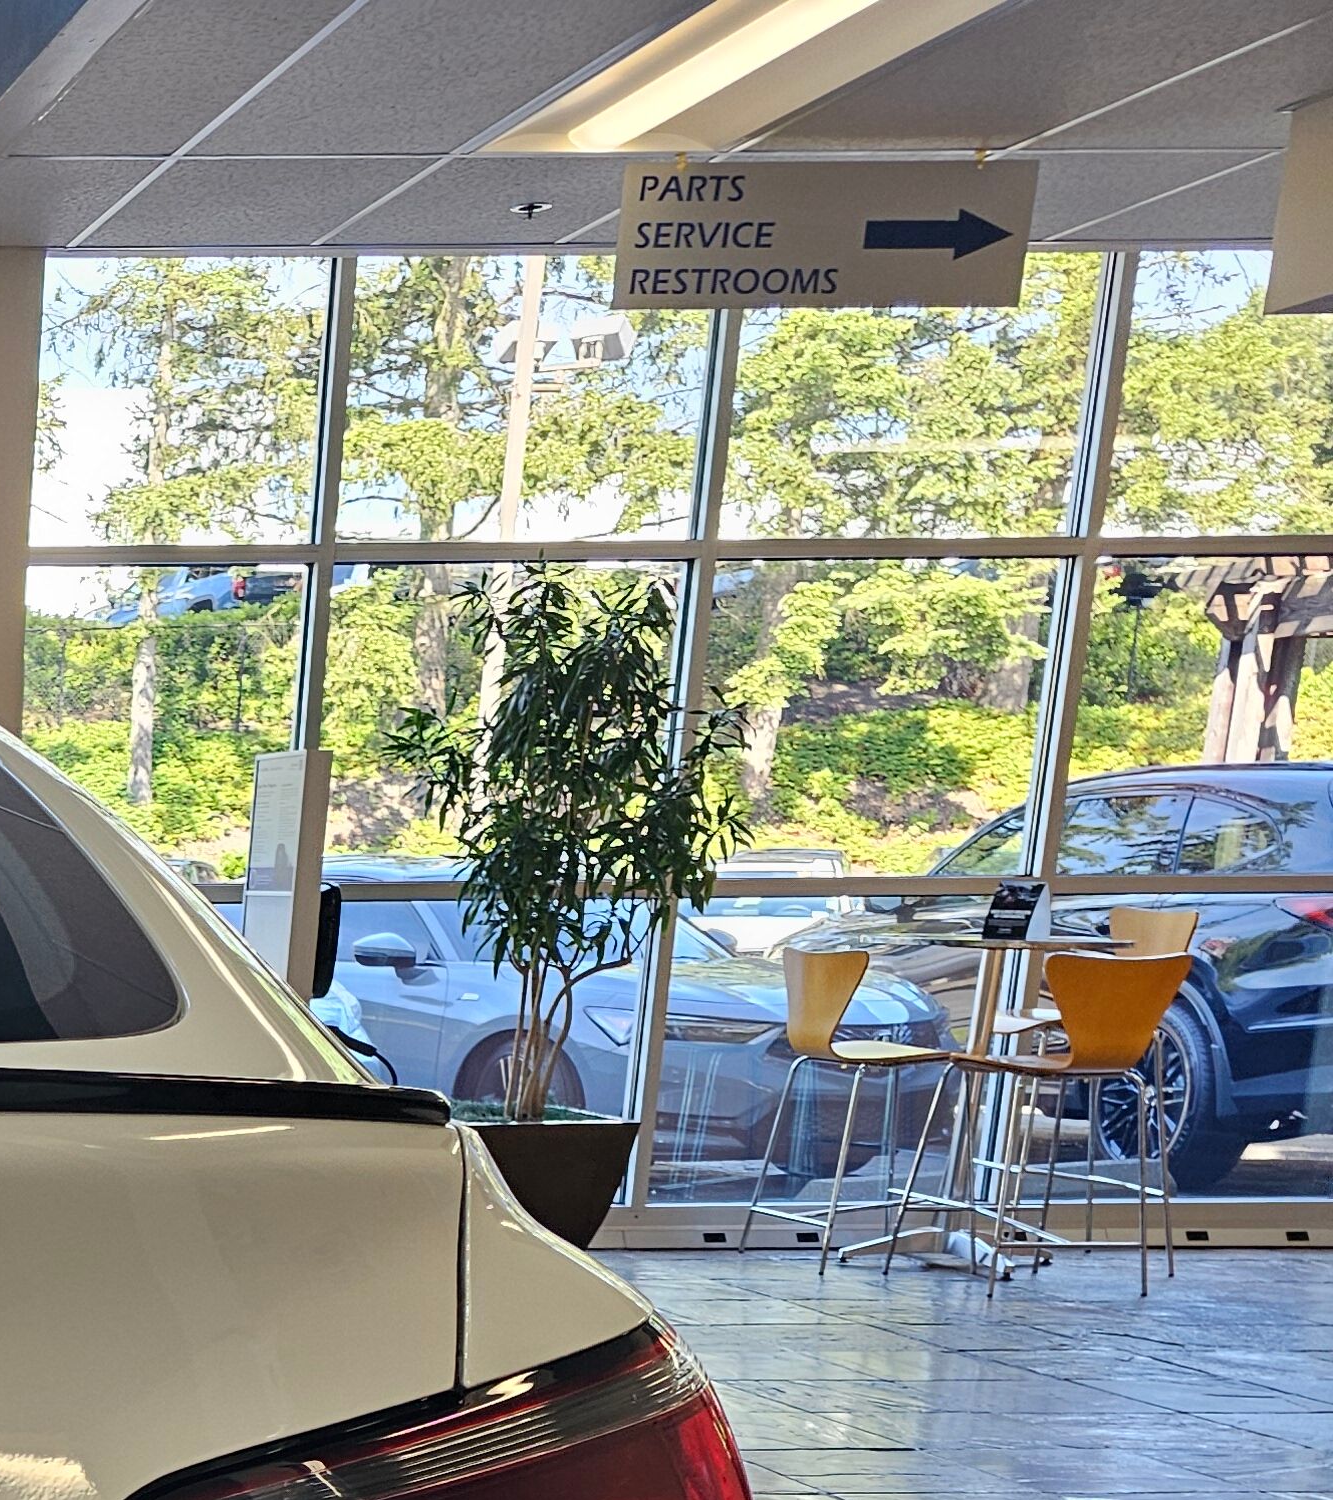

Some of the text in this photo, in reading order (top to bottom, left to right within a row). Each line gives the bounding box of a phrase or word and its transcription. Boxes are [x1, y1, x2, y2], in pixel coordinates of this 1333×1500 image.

[639, 175, 745, 201] PARTS
[634, 222, 776, 249] SERVICE
[629, 268, 839, 295] RESTROOMS
